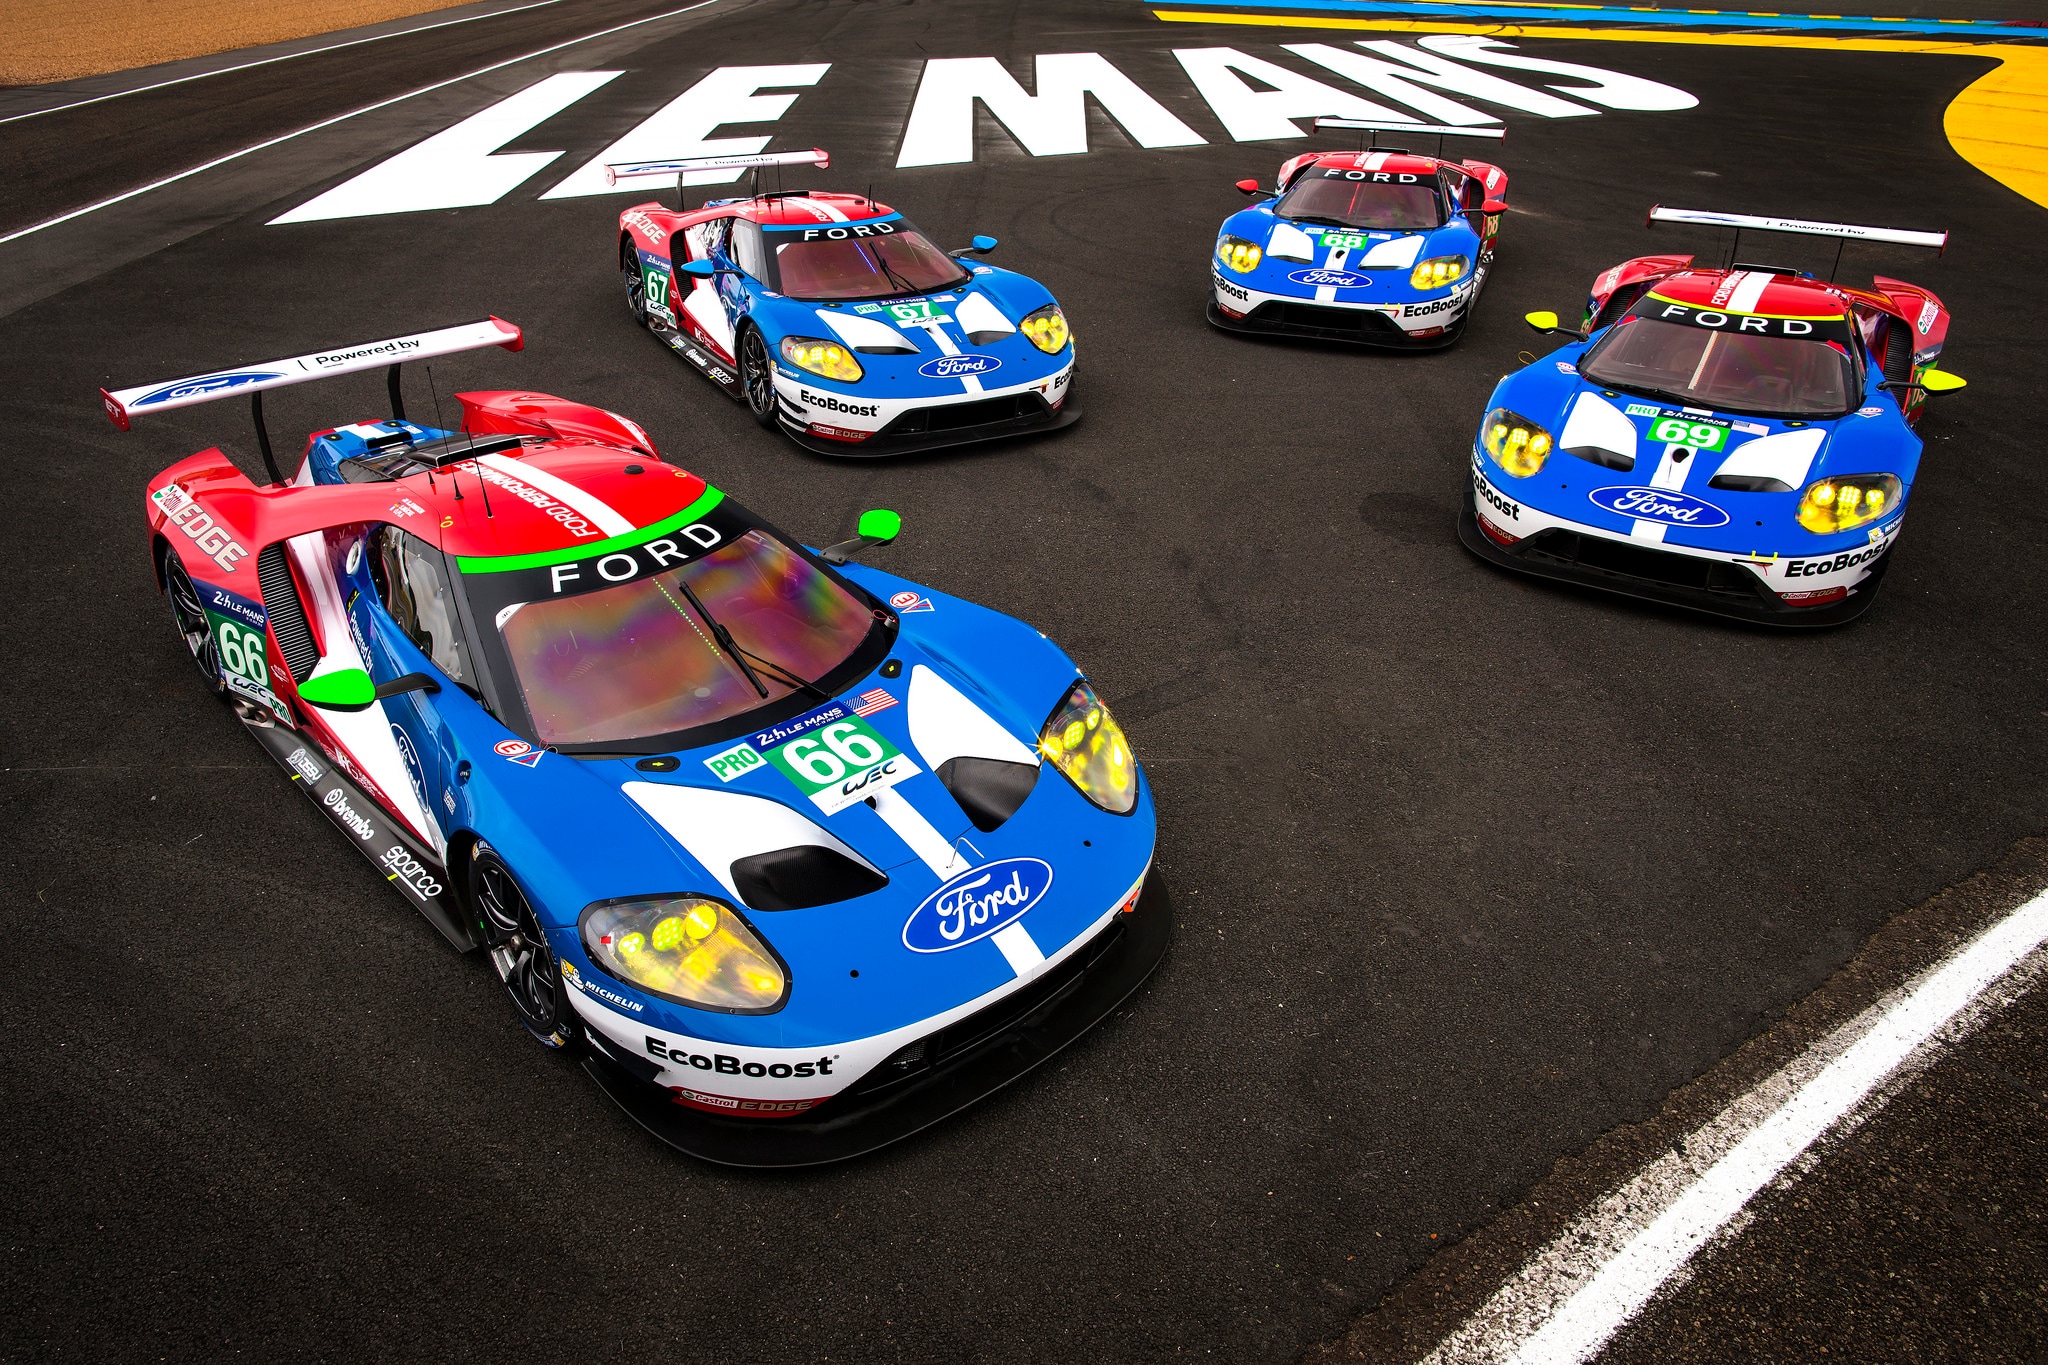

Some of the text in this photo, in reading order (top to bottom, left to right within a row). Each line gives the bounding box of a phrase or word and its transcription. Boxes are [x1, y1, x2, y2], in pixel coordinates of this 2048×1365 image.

[265, 34, 1700, 226] LE MANS
[1323, 168, 1418, 184] FORD
[803, 222, 894, 241] FORD
[1324, 234, 1363, 249] 68
[647, 271, 668, 304] 67
[1211, 267, 1249, 301] coBoost
[1303, 270, 1357, 286] Ford
[650, 302, 666, 314] WEC
[857, 304, 879, 313] PRO
[890, 301, 932, 320] 67
[1403, 293, 1464, 318] EcoBoost
[1660, 304, 1813, 336] FORD
[315, 339, 420, 365] Powered by
[936, 357, 987, 375] Ford
[801, 389, 878, 417] EcoBoost
[1628, 405, 1657, 417] PRO
[835, 429, 867, 440] EDGE
[1655, 419, 1721, 448] 69
[1613, 489, 1704, 522] Ford
[545, 505, 599, 538] FORD
[169, 502, 249, 573] EDGE
[550, 523, 722, 594] FORD
[1784, 537, 1889, 578] EcoBoost
[1809, 587, 1840, 598] EDGE
[230, 602, 243, 613] LE
[242, 606, 265, 624] MANS
[219, 622, 268, 687] 66
[350, 610, 374, 675] Powered by
[231, 677, 267, 698] WEC
[786, 722, 805, 735] LE
[804, 707, 843, 727] MANS
[709, 748, 760, 778] PRO
[782, 722, 884, 784] 66
[842, 760, 897, 796] WEC
[332, 796, 375, 841] brembo
[384, 845, 443, 897] sparco
[935, 870, 1030, 941] Ford
[584, 980, 644, 1013] MICHELIN
[645, 1034, 834, 1079] EcoBoost
[695, 1093, 814, 1111] Castrol EDGE
